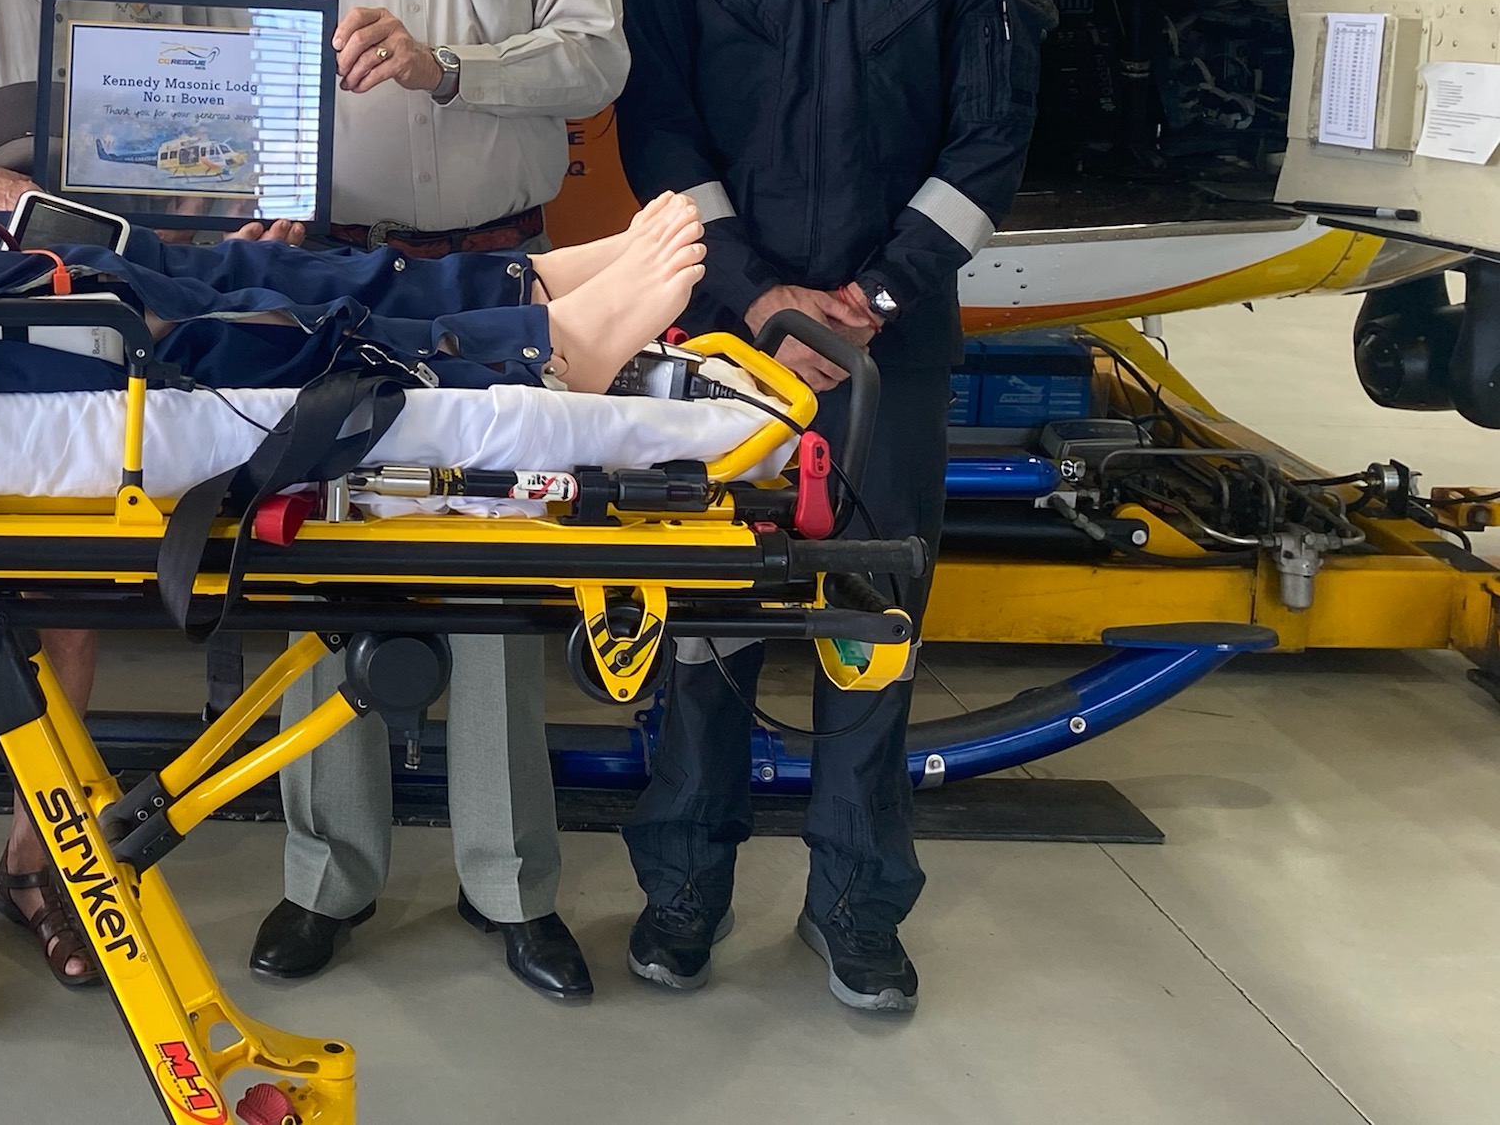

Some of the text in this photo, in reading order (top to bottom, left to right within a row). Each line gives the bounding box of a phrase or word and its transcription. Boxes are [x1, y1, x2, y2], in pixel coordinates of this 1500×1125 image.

[103, 75, 258, 96] Kennedy Masonic Lodg
[181, 93, 224, 106] Bowen
[103, 105, 130, 115] Thank
[133, 108, 151, 118] you
[154, 107, 167, 118] for
[171, 109, 190, 119] your
[194, 111, 230, 120] generous
[35, 787, 140, 962] stryker
[160, 1041, 218, 1110] M-1
